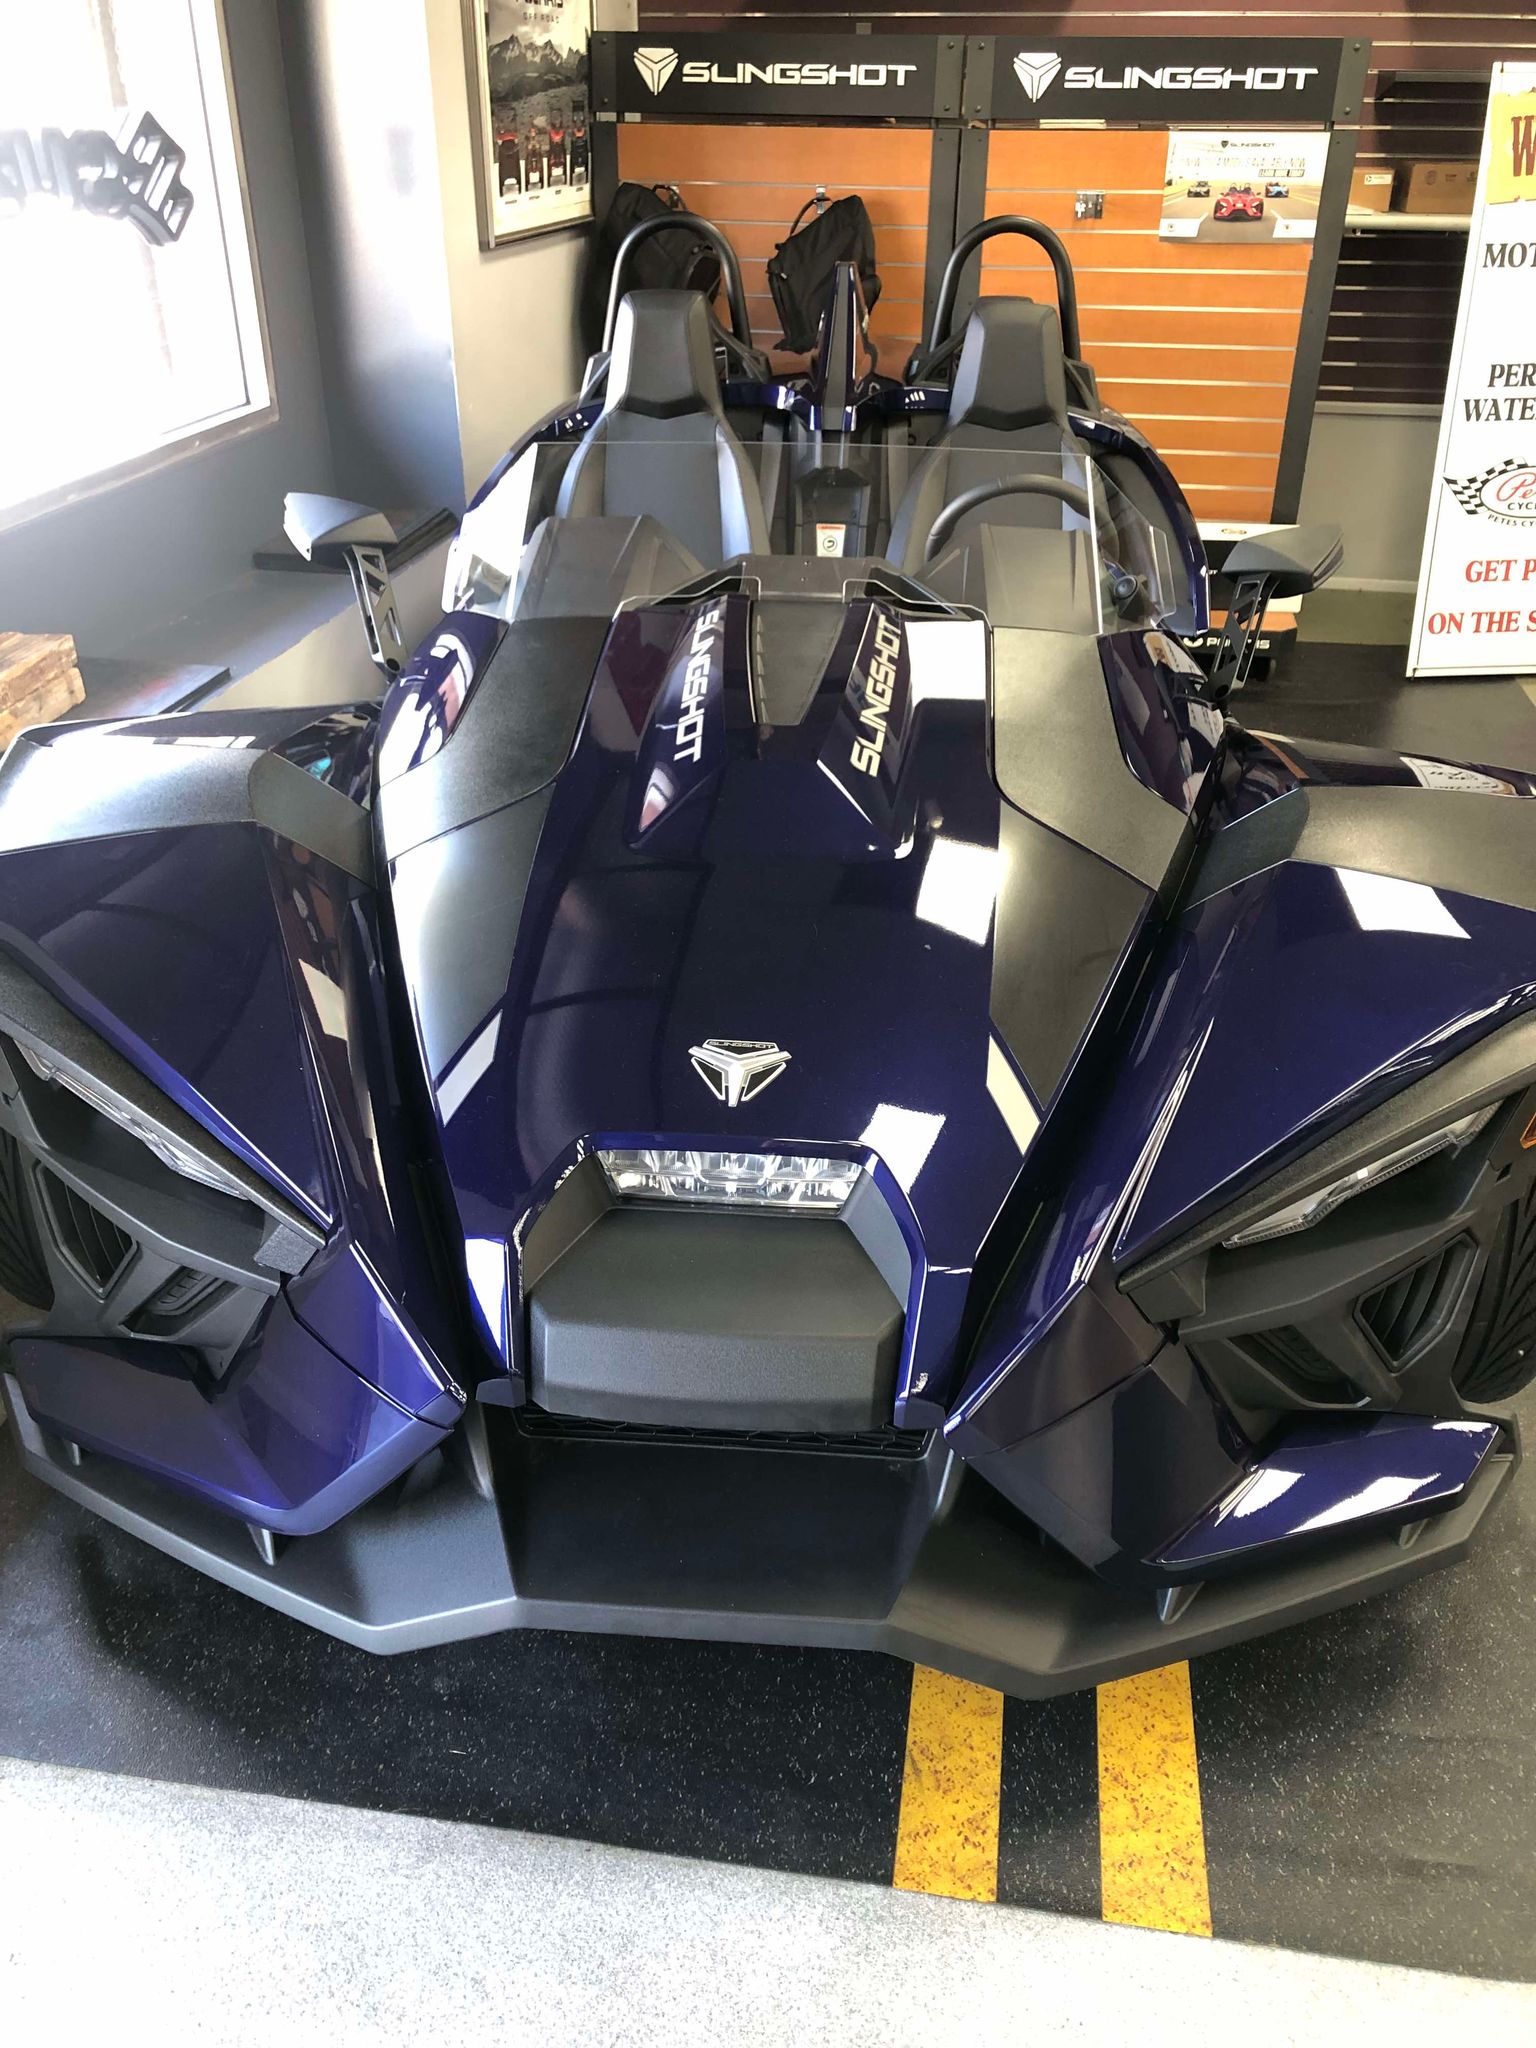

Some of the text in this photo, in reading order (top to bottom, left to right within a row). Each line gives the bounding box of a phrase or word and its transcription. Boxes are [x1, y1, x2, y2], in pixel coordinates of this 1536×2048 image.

[682, 61, 918, 87] SLINGSHOT
[1064, 66, 1319, 90] SLINGSHOT
[1487, 363, 1536, 388] PER
[1463, 397, 1536, 422] WATE
[1507, 501, 1536, 511] CYC
[1488, 514, 1517, 526] PETES
[1465, 559, 1518, 583] GET
[1428, 612, 1465, 635] ON
[1471, 610, 1521, 633] THE
[673, 609, 720, 763] SLINGSHOT
[850, 614, 901, 778] SLINGSHOT
[707, 1041, 775, 1049] SLINGSHOT
